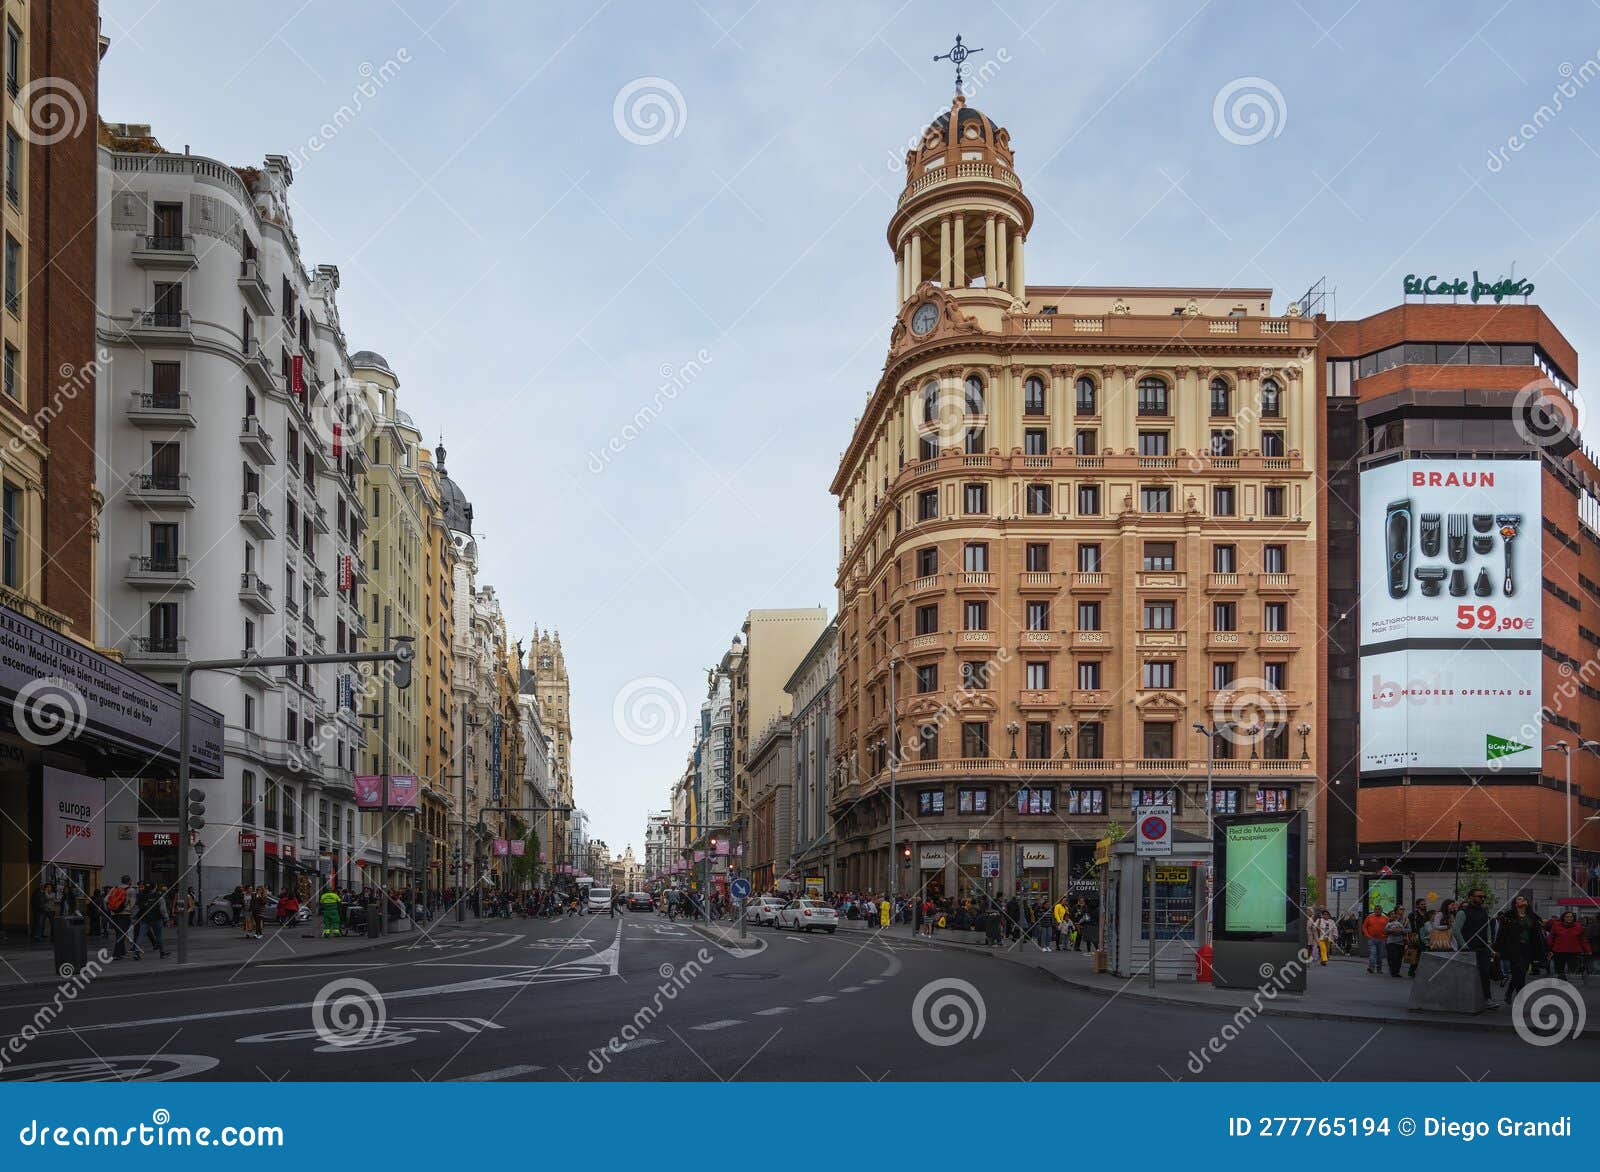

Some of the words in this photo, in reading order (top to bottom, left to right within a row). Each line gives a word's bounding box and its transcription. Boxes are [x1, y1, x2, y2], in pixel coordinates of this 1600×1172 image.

[1404, 274, 1422, 294] El
[1424, 275, 1468, 295] Corte
[1412, 472, 1494, 487] BRAUN
[1372, 616, 1416, 627] MULTIGROOM
[1456, 604, 1535, 632] 59,90€
[51, 642, 84, 662] TIEMPO
[0, 634, 25, 654] sición
[78, 667, 92, 684] bien
[122, 690, 150, 708] confronta
[150, 700, 158, 712] los
[2, 655, 46, 680] escenarios
[89, 691, 99, 702] en
[100, 697, 120, 713] guerra
[142, 711, 152, 726] hoy
[1372, 691, 1394, 700] LAS
[58, 800, 91, 818] europa
[66, 822, 92, 838] press
[1334, 878, 1344, 889] P
